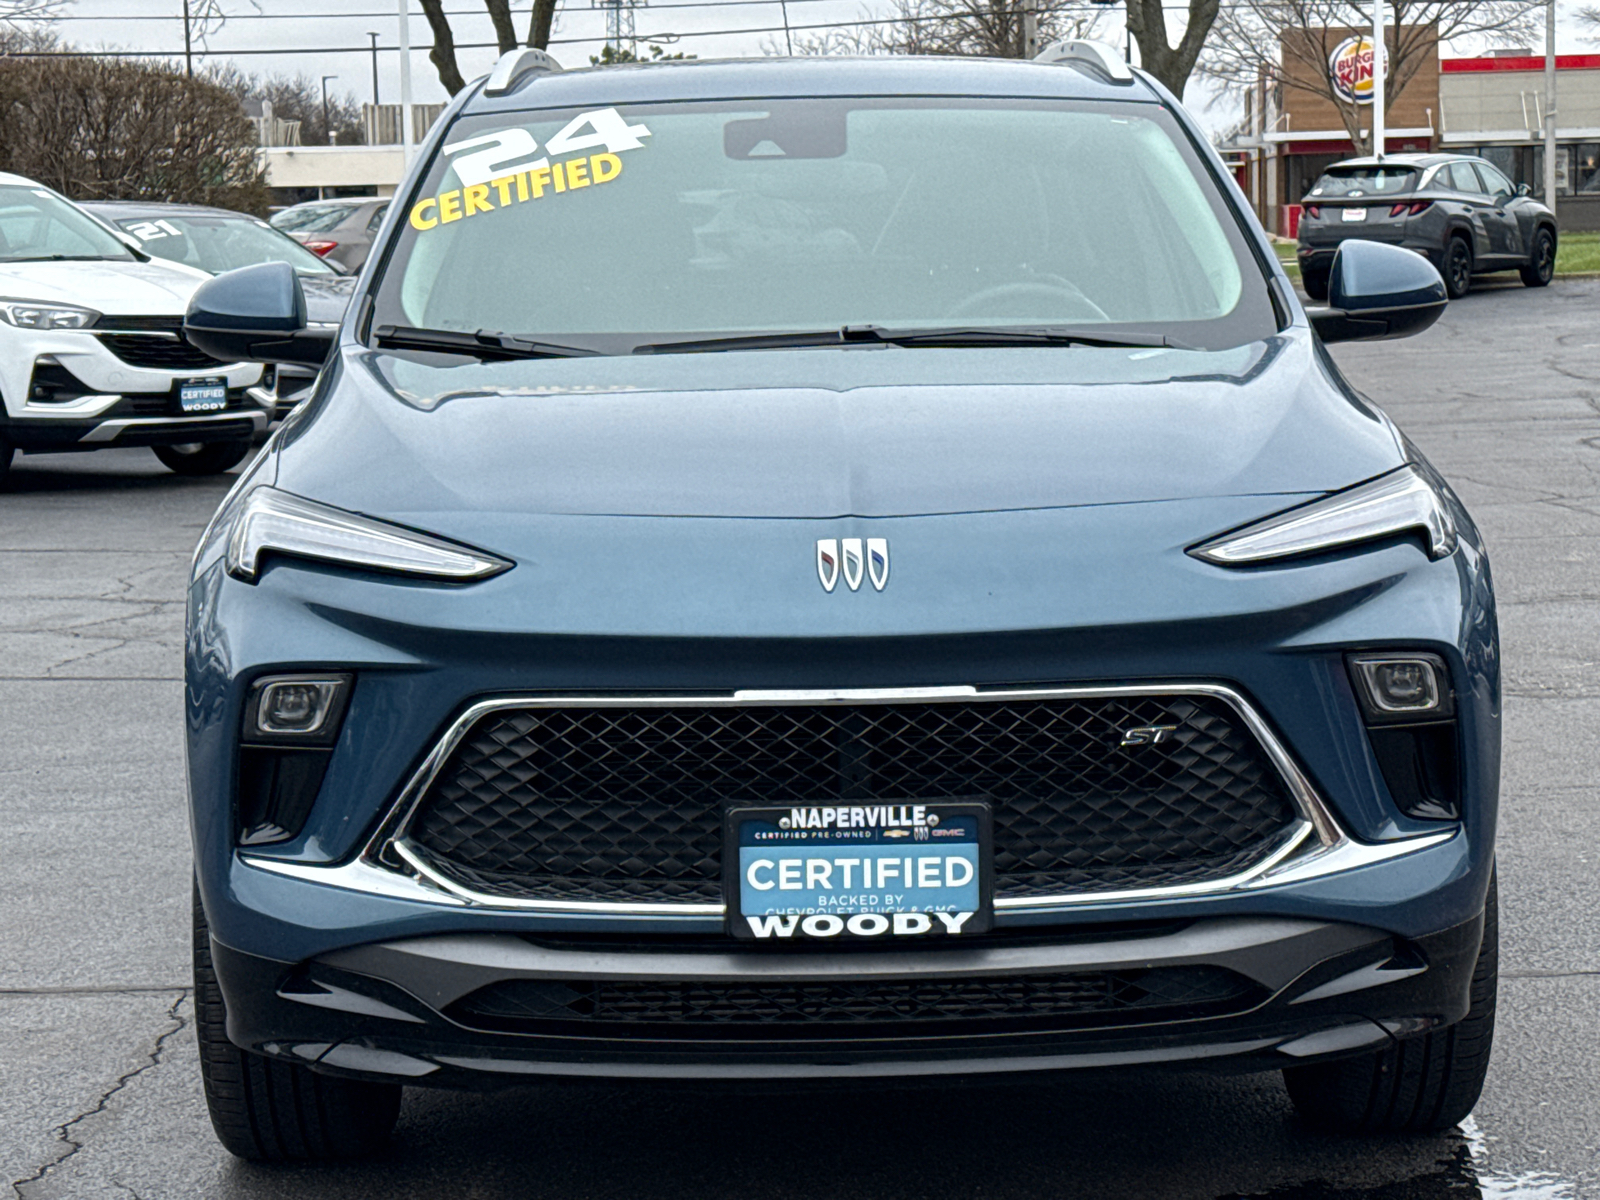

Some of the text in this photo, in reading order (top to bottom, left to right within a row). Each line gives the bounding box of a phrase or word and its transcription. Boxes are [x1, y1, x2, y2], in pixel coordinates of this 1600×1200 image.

[1340, 62, 1387, 87] KIN
[442, 107, 652, 188] 24
[409, 152, 622, 231] CERTIFIED
[126, 219, 182, 241] 21
[181, 388, 225, 399] CERTIFIED
[182, 402, 226, 411] WOODY
[1120, 721, 1177, 746] ST
[791, 806, 926, 829] NAPERVILLE
[754, 828, 965, 840] CERTIFIED PRE-OWNED GMC
[746, 856, 974, 891] CERTIFIED
[818, 894, 904, 906] BACKED BY
[745, 911, 975, 938] WOODY
